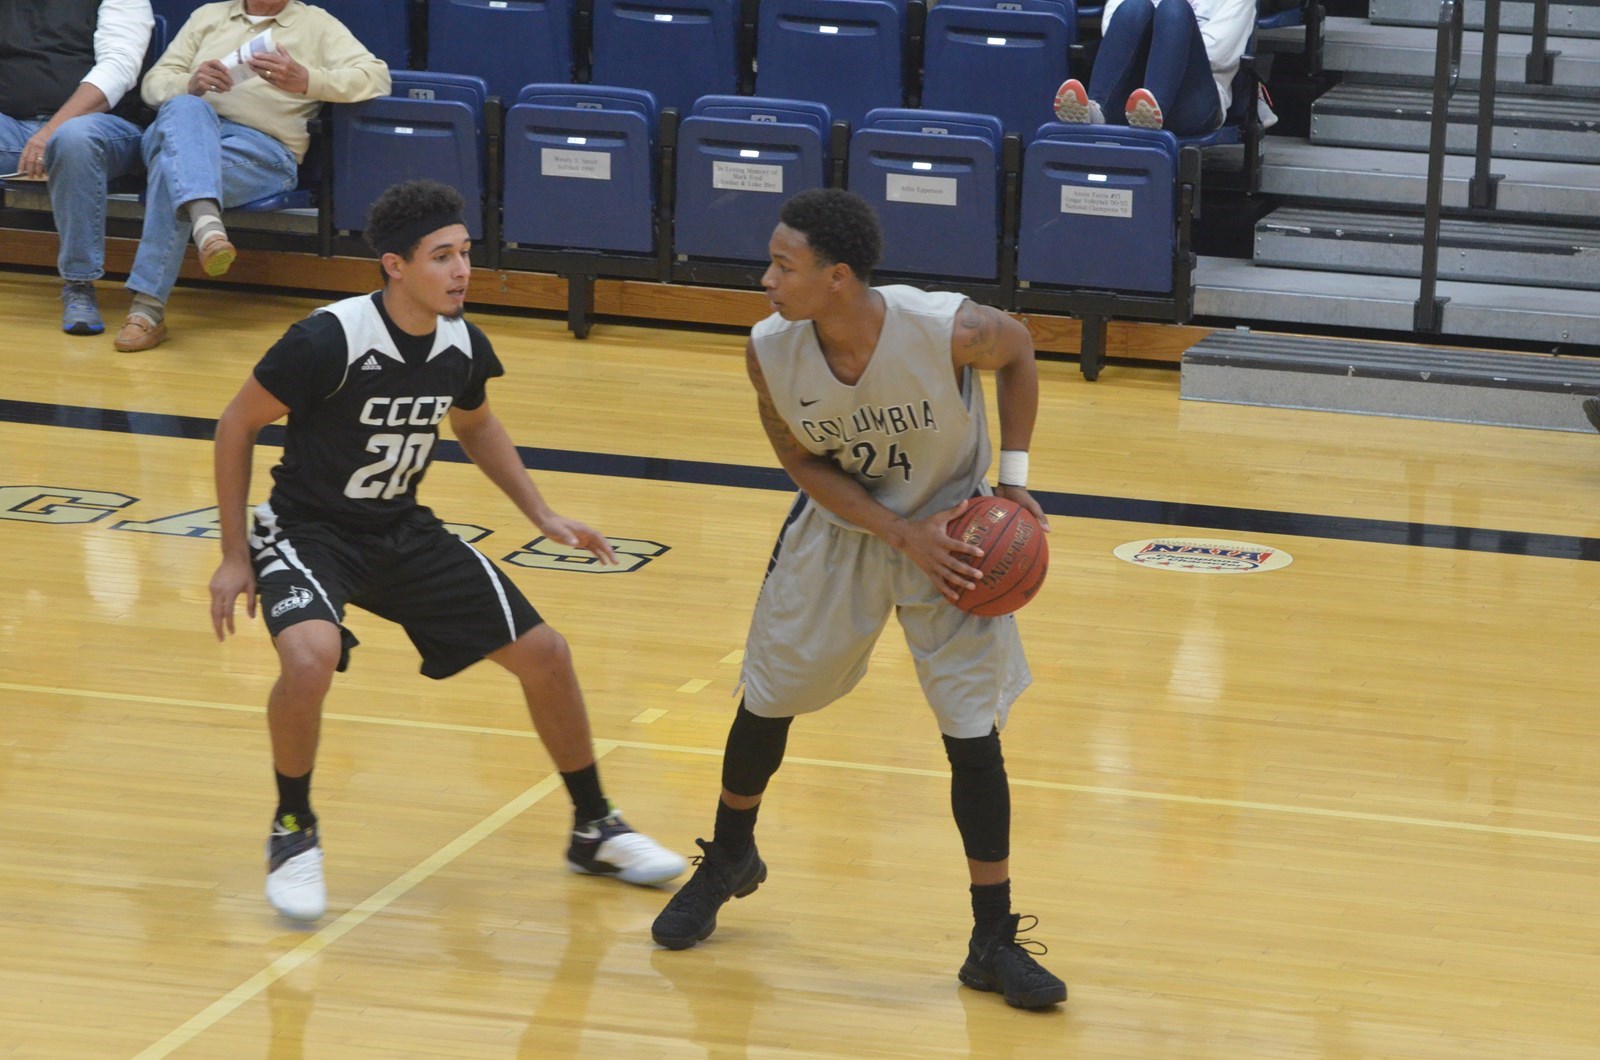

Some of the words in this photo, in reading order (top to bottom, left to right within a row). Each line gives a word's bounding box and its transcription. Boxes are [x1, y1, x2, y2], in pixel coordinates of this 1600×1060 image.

[747, 167, 769, 176] Memory
[359, 396, 453, 427] CCCB
[801, 399, 940, 443] COLUMBIA
[344, 432, 436, 500] 20
[851, 440, 913, 483] 24
[980, 518, 1035, 590] SPALDING
[1146, 543, 1262, 562] NAIA
